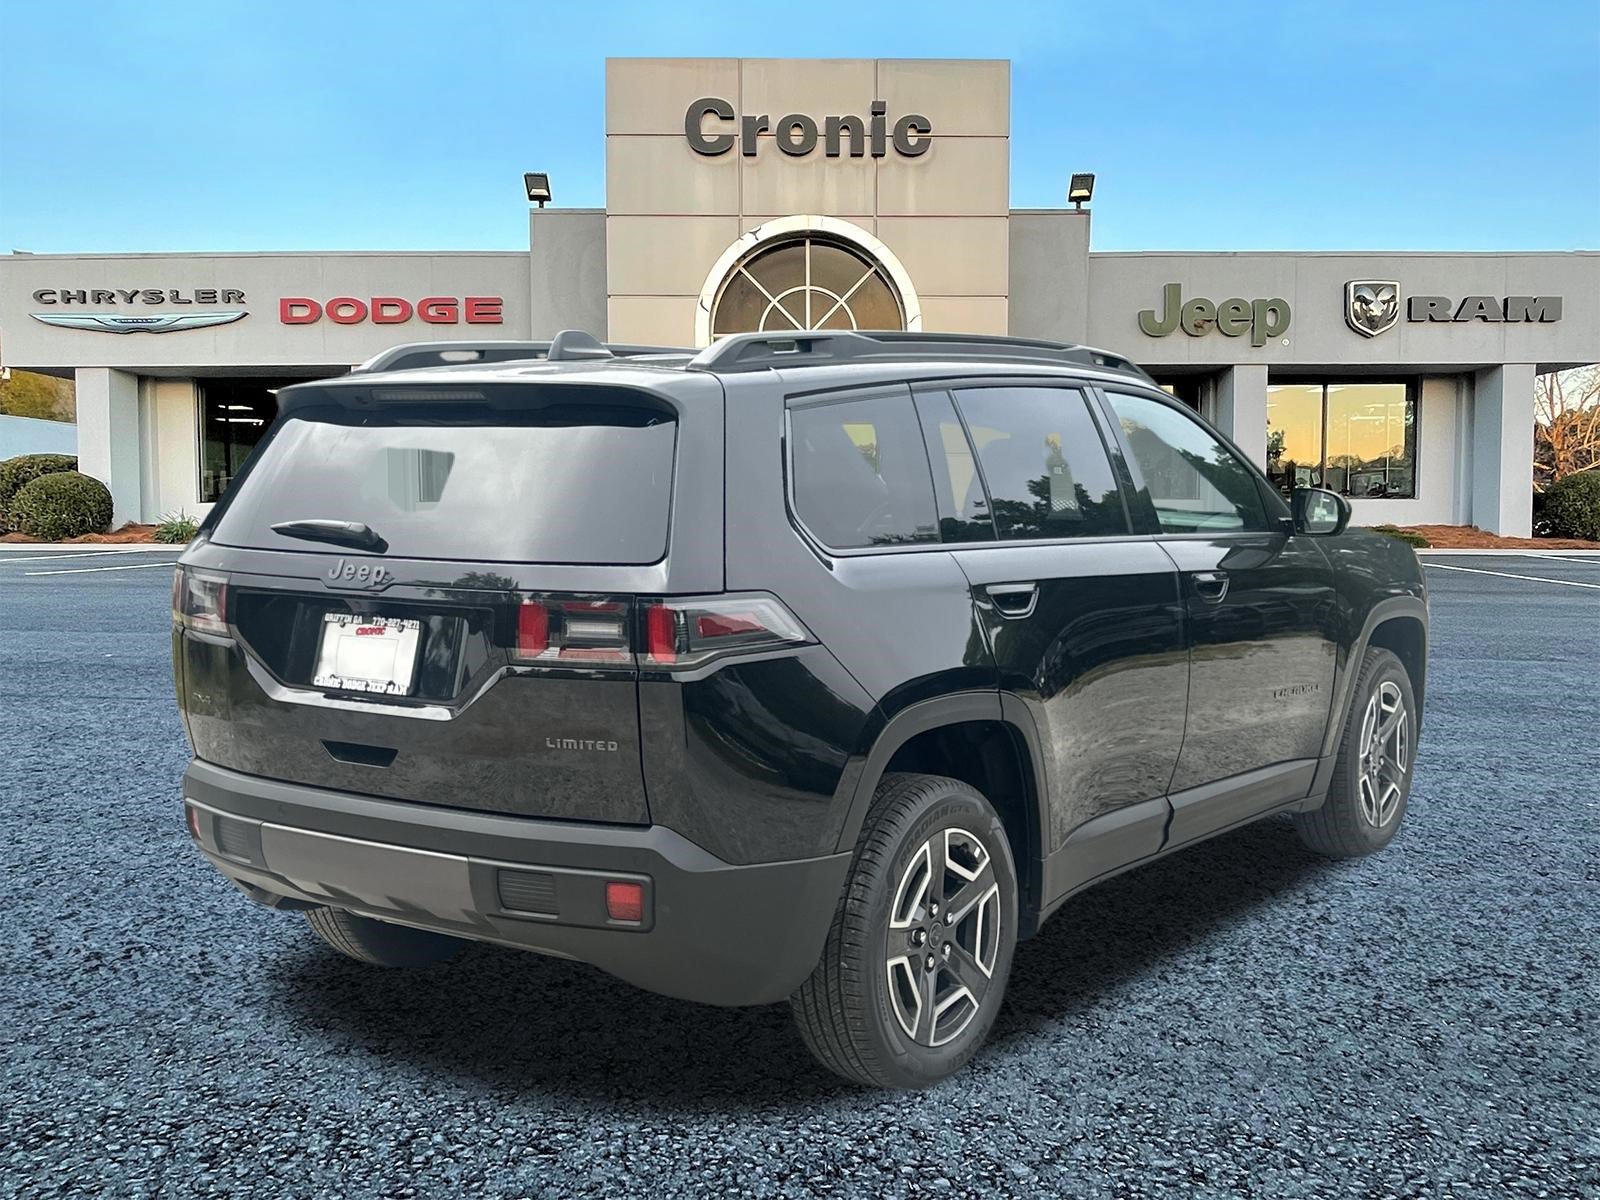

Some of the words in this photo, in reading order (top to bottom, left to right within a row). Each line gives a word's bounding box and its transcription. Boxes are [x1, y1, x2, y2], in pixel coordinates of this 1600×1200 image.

[685, 97, 932, 157] Cronic
[32, 289, 247, 305] CHRYSLER
[1407, 296, 1563, 323] RAM
[279, 297, 503, 325] DODGE
[1138, 283, 1291, 348] Jeep
[328, 559, 386, 586] Jeep
[545, 737, 618, 752] LIMITED
